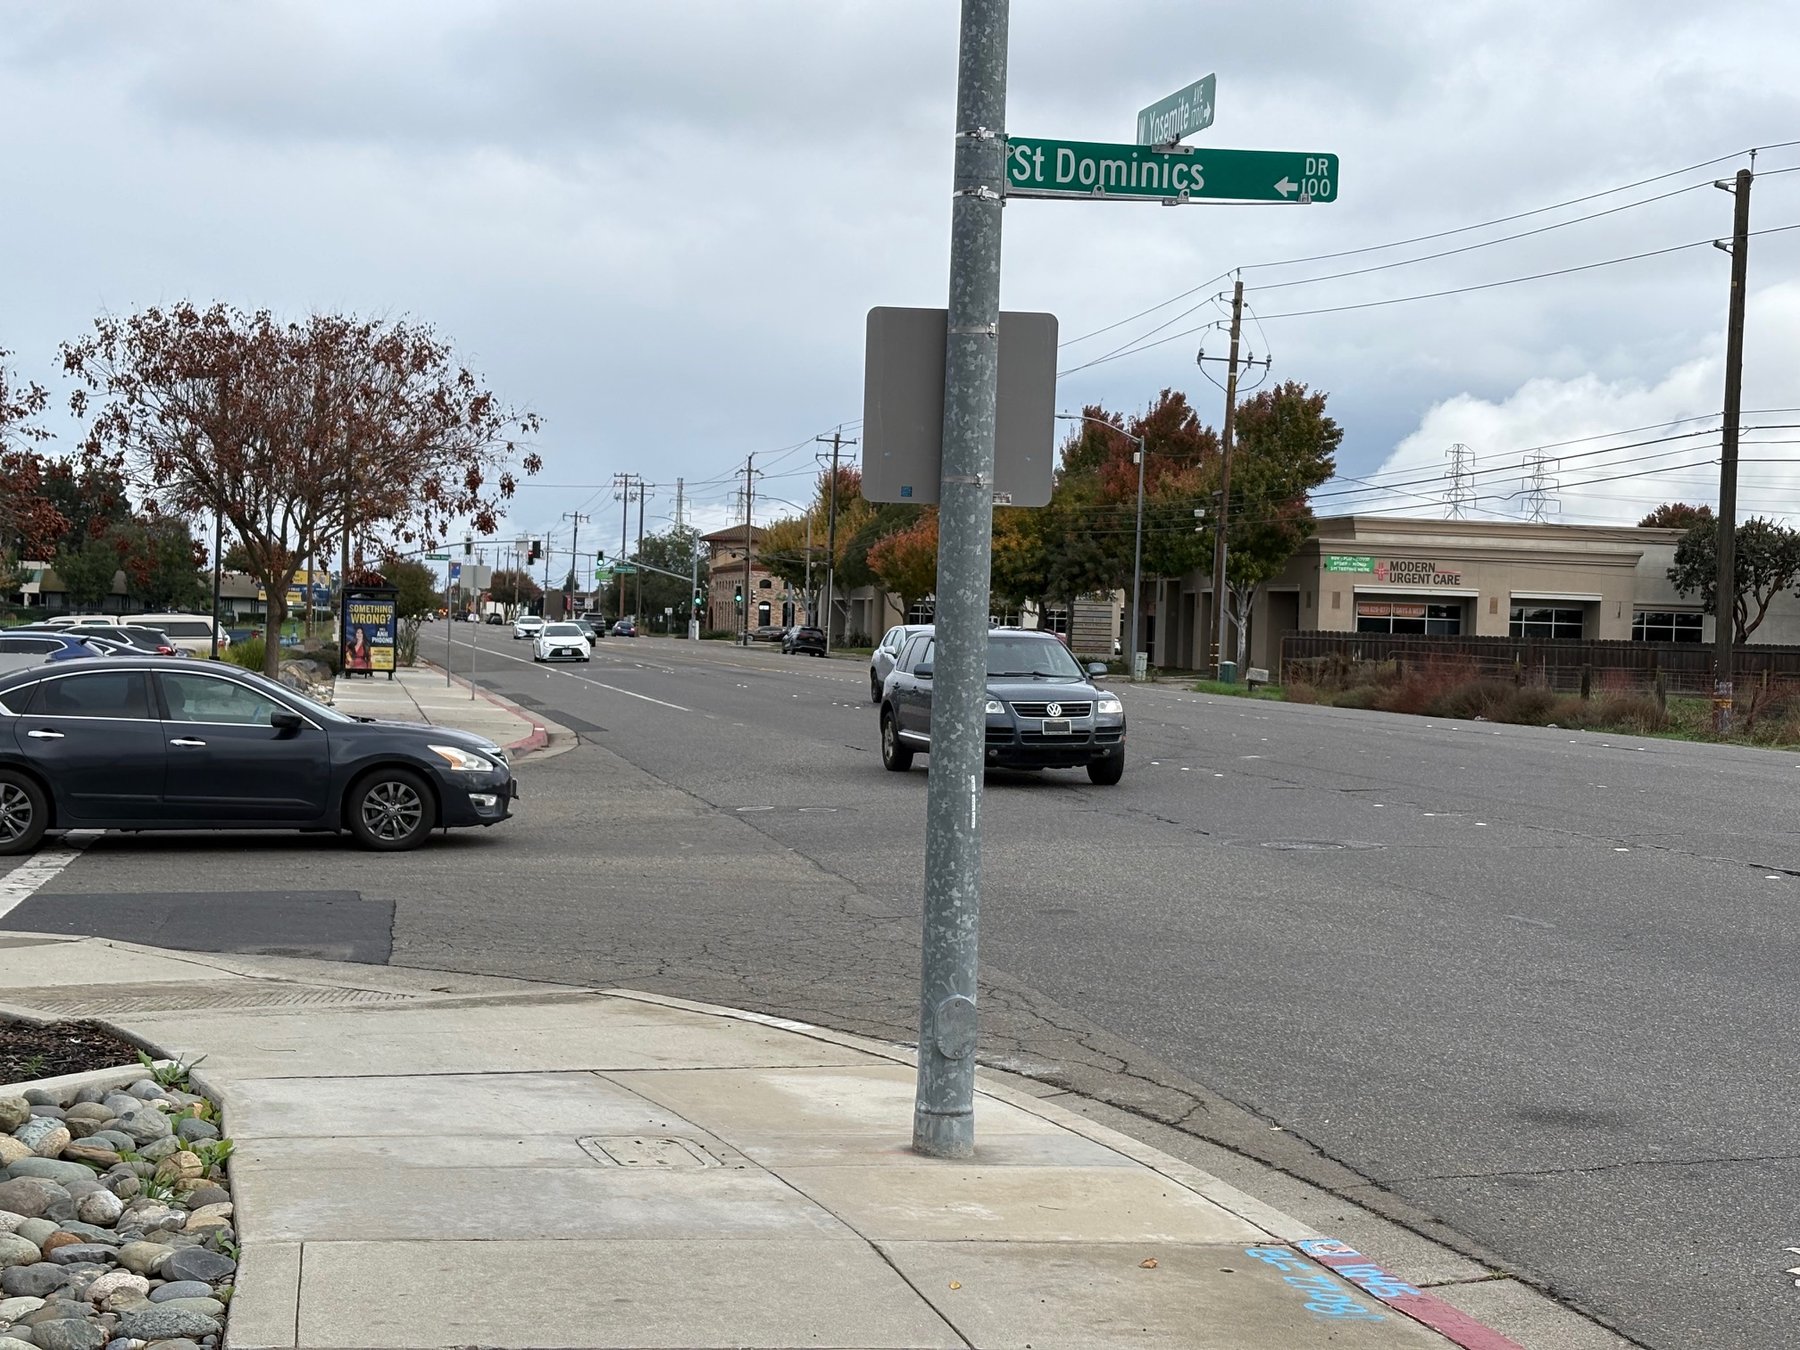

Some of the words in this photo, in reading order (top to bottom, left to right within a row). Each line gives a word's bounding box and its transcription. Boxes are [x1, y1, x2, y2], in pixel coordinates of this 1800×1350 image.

[1139, 116, 1147, 145] W
[1150, 97, 1190, 144] Yosemite
[1192, 84, 1204, 105] AVE
[1012, 145, 1045, 182] St
[1056, 148, 1205, 190] Dominics
[1305, 158, 1328, 177] DR
[1301, 179, 1331, 197] 100
[1389, 561, 1436, 573] MODERN
[1389, 573, 1431, 584] URGENT
[1433, 574, 1461, 585] CARE
[349, 604, 393, 613] SOMETHING
[350, 613, 392, 624] WRONG?
